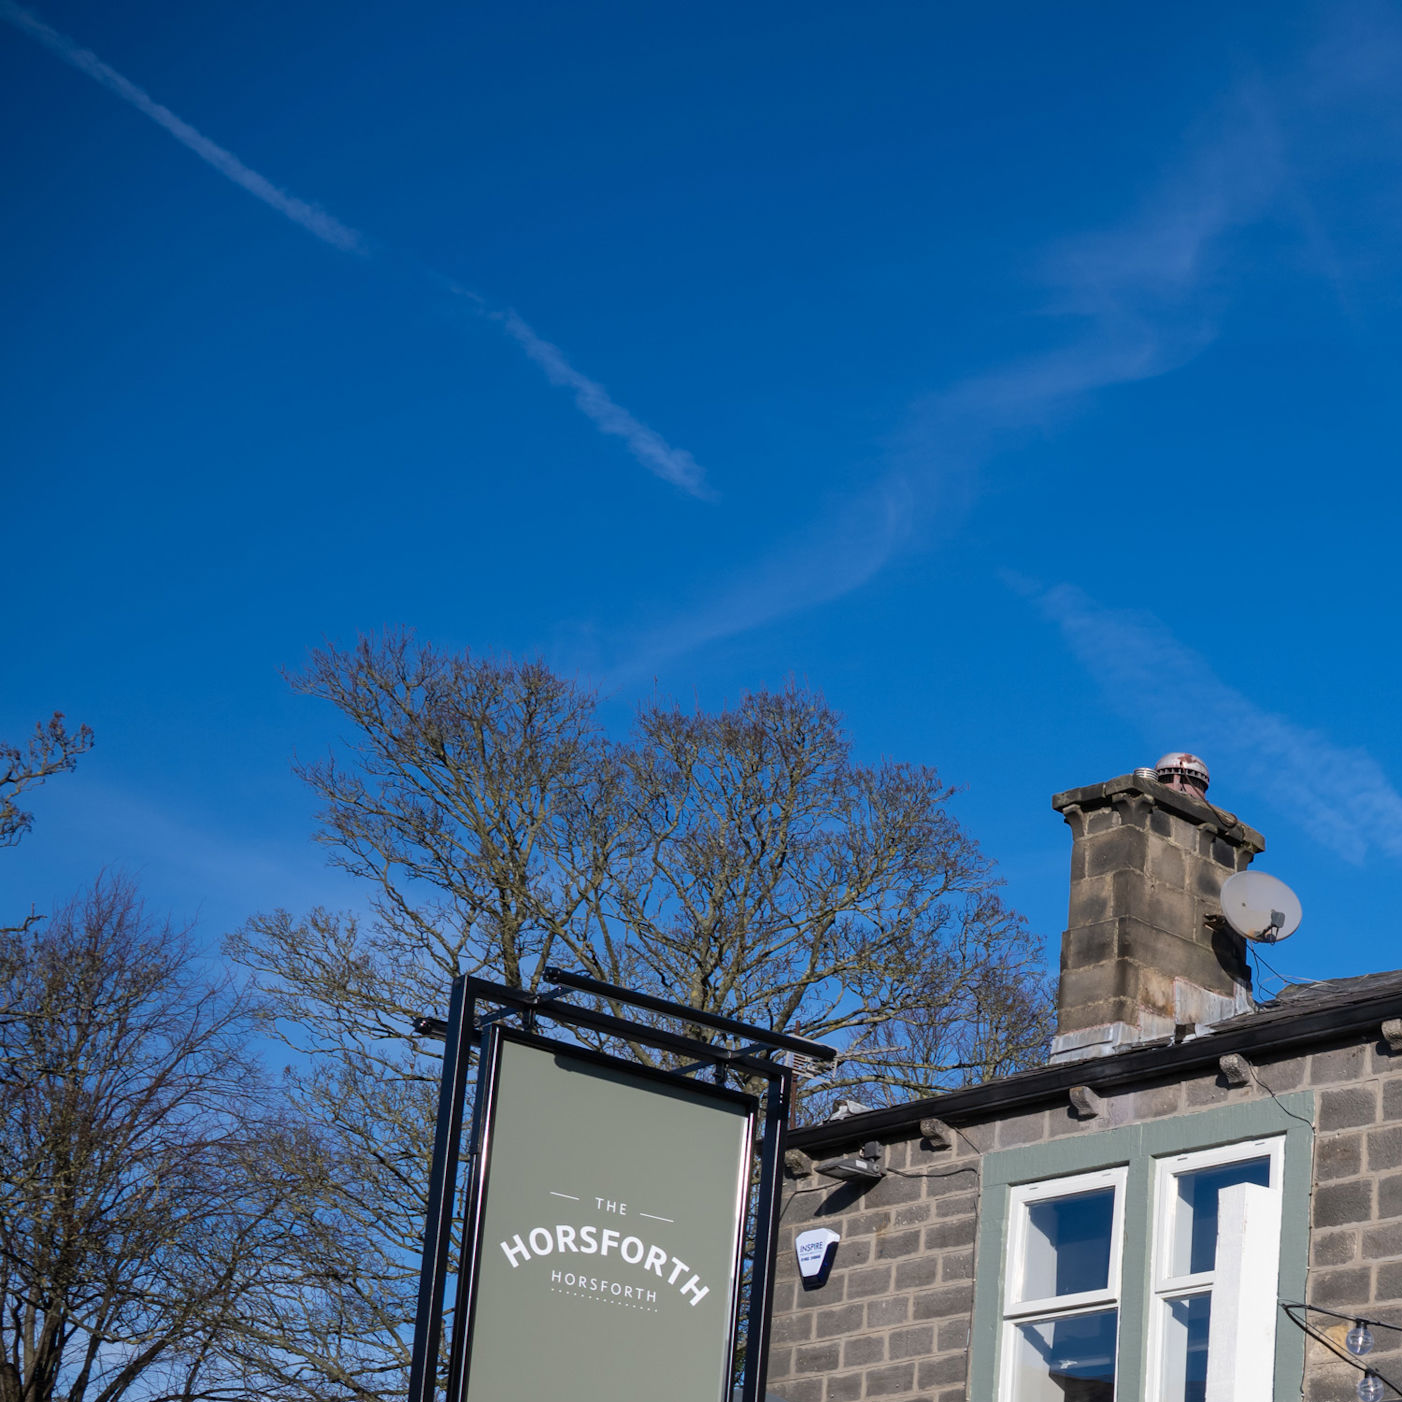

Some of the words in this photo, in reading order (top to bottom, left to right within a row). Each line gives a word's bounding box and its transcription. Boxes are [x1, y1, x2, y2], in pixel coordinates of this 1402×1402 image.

[594, 1196, 629, 1216] THE
[499, 1224, 712, 1307] HORSFORTH
[551, 1269, 658, 1304] HORSFORTH
